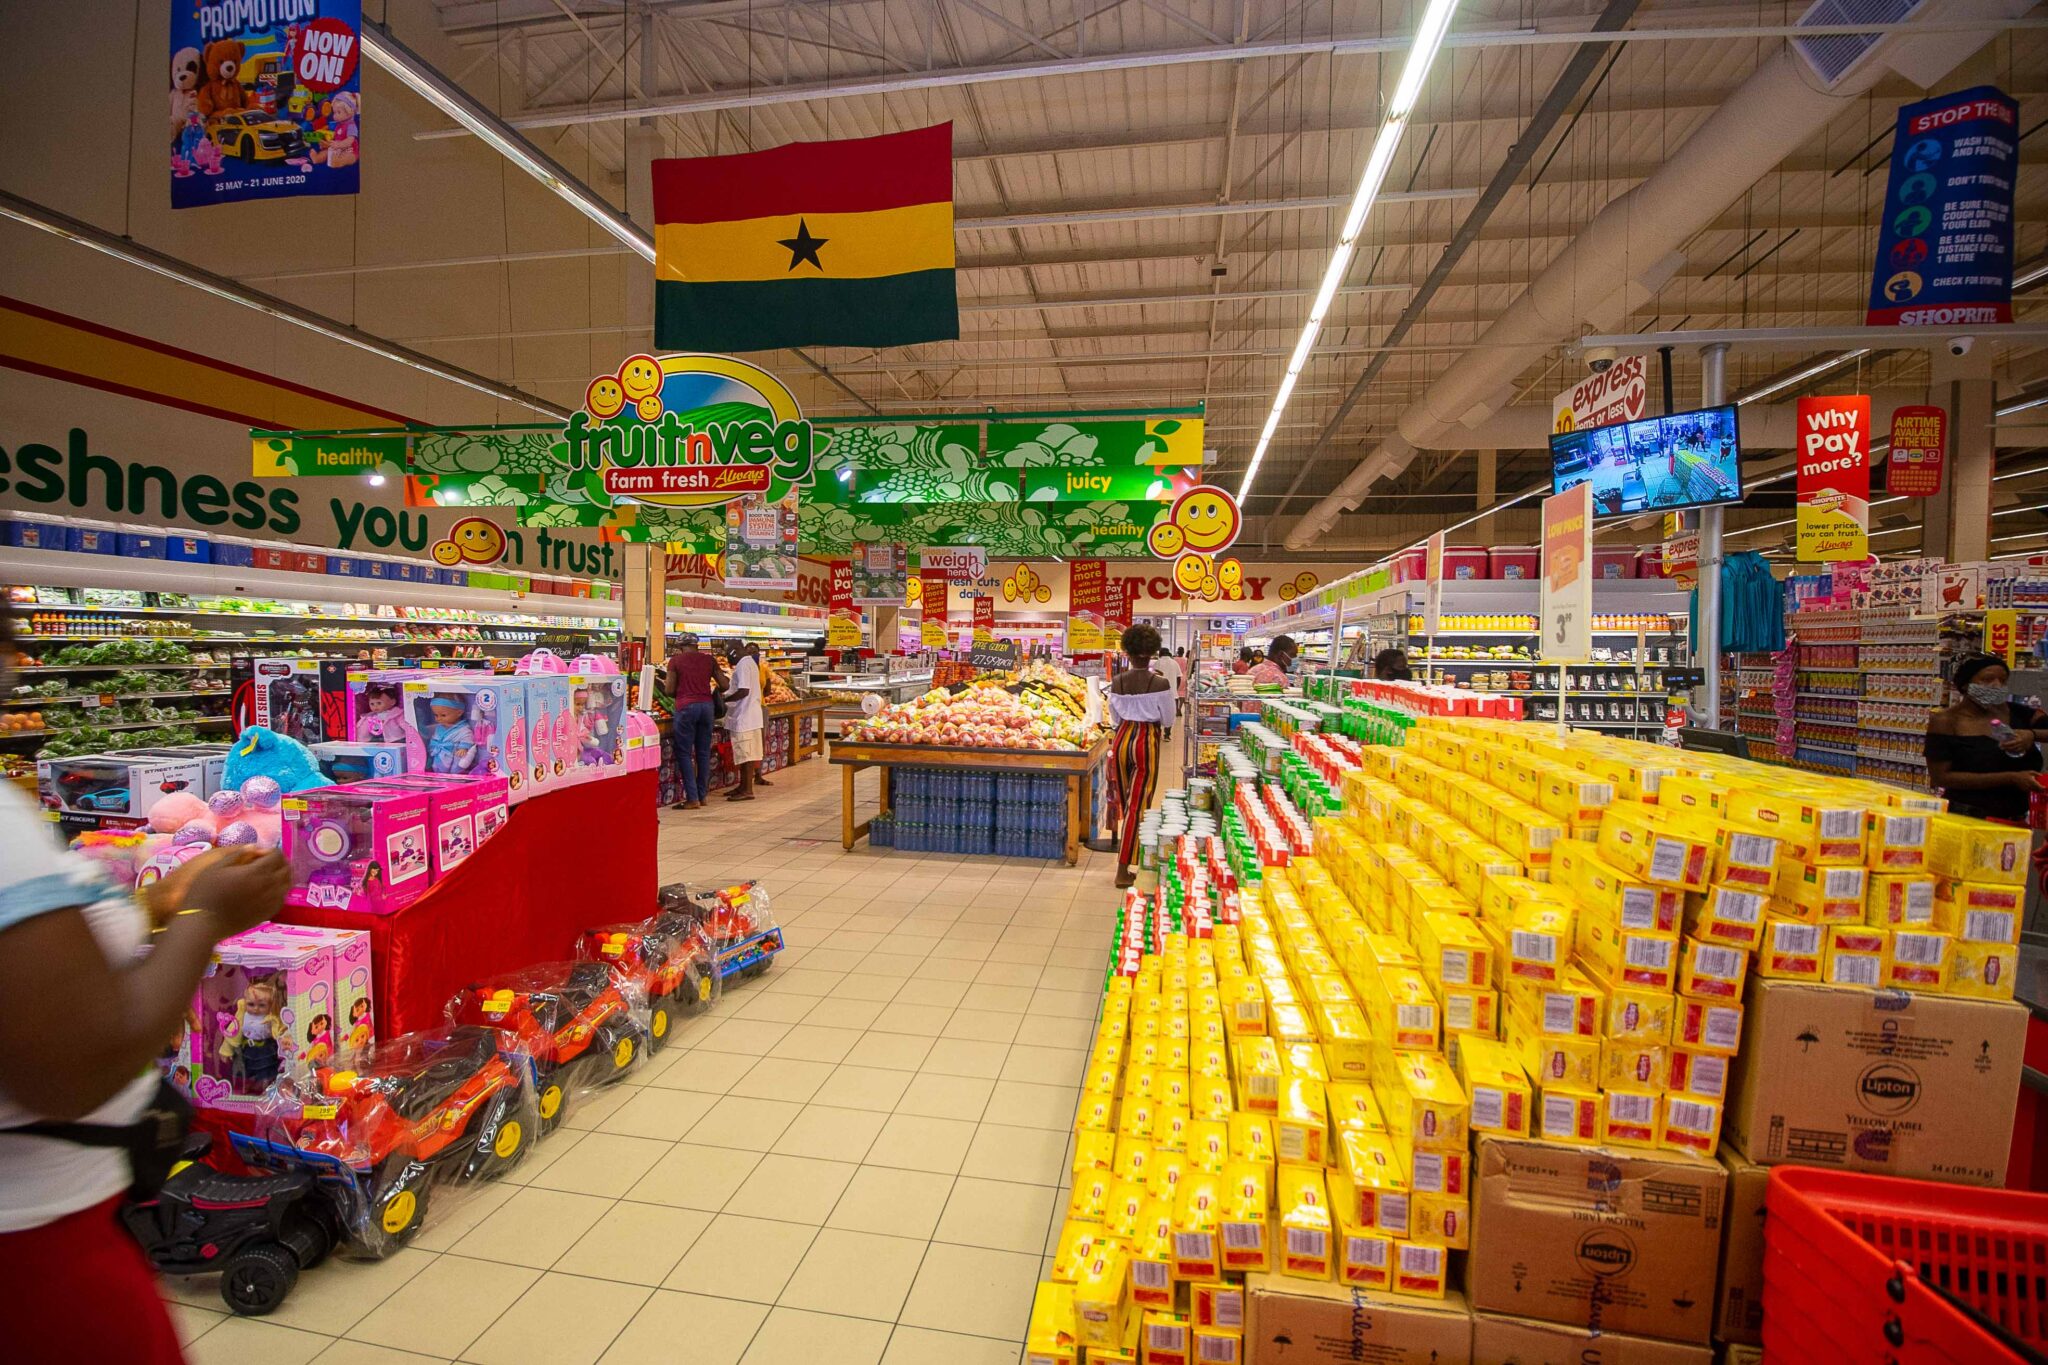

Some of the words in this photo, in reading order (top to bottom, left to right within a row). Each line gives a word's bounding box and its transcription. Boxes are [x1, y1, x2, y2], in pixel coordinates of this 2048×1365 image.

[200, 0, 316, 38] PROMOTION
[304, 30, 354, 57] NOW
[301, 54, 345, 84] ON!
[1918, 105, 1971, 130] STOP
[1954, 136, 1982, 148] WASH
[1952, 147, 1973, 157] AND
[215, 182, 225, 191] 25
[226, 180, 243, 190] MAY
[250, 178, 260, 187] 21
[262, 176, 284, 187] JUNE
[286, 175, 306, 185] 2020
[1948, 175, 1977, 187] DON'T
[1944, 202, 1957, 212] BE
[1960, 201, 1981, 210] SURE
[1942, 211, 1974, 221] COUGH
[1942, 221, 1967, 230] YOUR
[1939, 236, 1952, 245] BE
[1955, 235, 1976, 243] SAFE
[1938, 244, 1978, 254] DISTANCE
[1945, 254, 1975, 263] METRE
[1933, 277, 1963, 287] CHECK
[1899, 307, 1997, 325] SHOPRITE
[1572, 355, 1643, 413] express
[1596, 410, 1606, 425] or
[1607, 401, 1624, 420] less
[1806, 408, 1859, 432] Why
[1894, 416, 1941, 428] AIRTIME
[1894, 427, 1940, 437] AVAILABLE
[1805, 430, 1860, 457] Pay
[1894, 437, 1904, 447] AT
[1904, 437, 1920, 447] THE
[1921, 437, 1940, 447] TILLS
[316, 447, 384, 468] healthy
[1802, 451, 1863, 477] more?
[611, 472, 653, 488] farm
[662, 470, 709, 488] fresh
[712, 469, 765, 488] Always
[1066, 471, 1112, 494] juicy
[0, 428, 301, 535] shness
[330, 498, 428, 551] you
[1090, 522, 1144, 538] healthy
[1833, 522, 1859, 531] prices
[537, 527, 620, 578] trust.
[1669, 538, 1700, 558] expres
[928, 552, 978, 568] weigh
[834, 566, 852, 578] Wh
[947, 568, 967, 576] here
[1074, 561, 1100, 572] Save
[1073, 570, 1101, 581] more
[834, 579, 853, 591] Pa
[949, 578, 972, 587] resh
[977, 577, 1001, 587] cuts
[797, 573, 831, 606] GGS
[959, 589, 985, 599] daily
[1073, 586, 1101, 597] Lower
[1105, 585, 1122, 593] Pay
[1073, 595, 1101, 606] Prices
[1104, 593, 1123, 601] Less
[1104, 600, 1123, 608] every
[1103, 607, 1123, 617] day!
[257, 683, 267, 712] SERIES
[1866, 1079, 1911, 1094] Lipton
[1846, 1114, 1888, 1128] YELLOW
[1892, 1120, 1924, 1131] LABEL
[1585, 1247, 1628, 1264] Lipton
